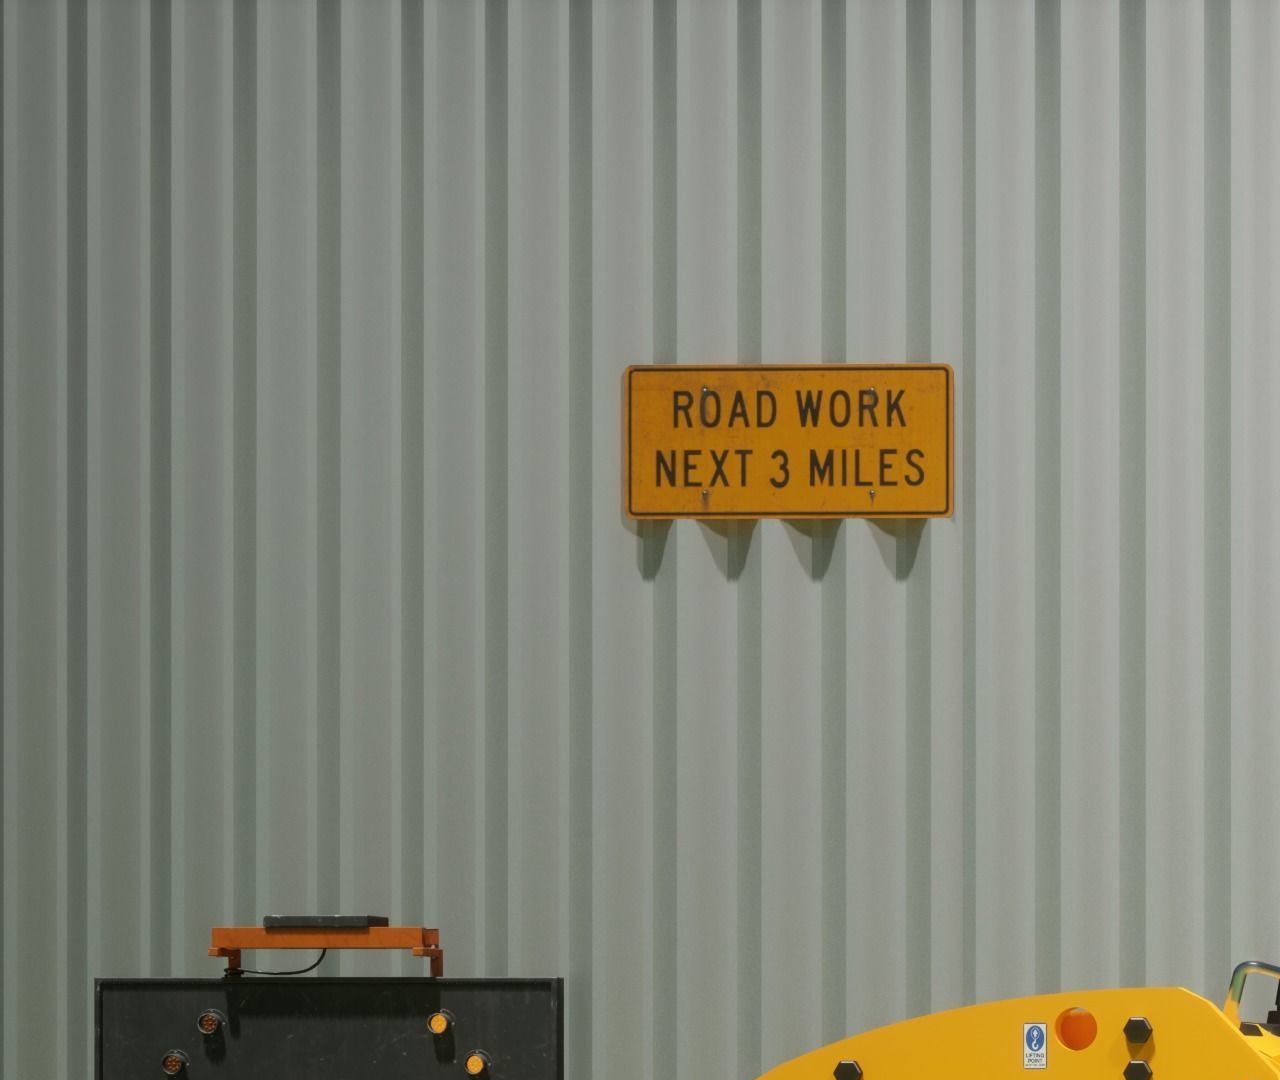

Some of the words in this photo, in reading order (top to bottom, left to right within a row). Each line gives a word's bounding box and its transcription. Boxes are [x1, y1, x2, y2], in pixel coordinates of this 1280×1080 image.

[672, 389, 778, 429] ROAD
[795, 388, 908, 428] WORK
[655, 449, 754, 488] NEXT
[769, 449, 790, 489] 3
[809, 448, 926, 488] MILES
